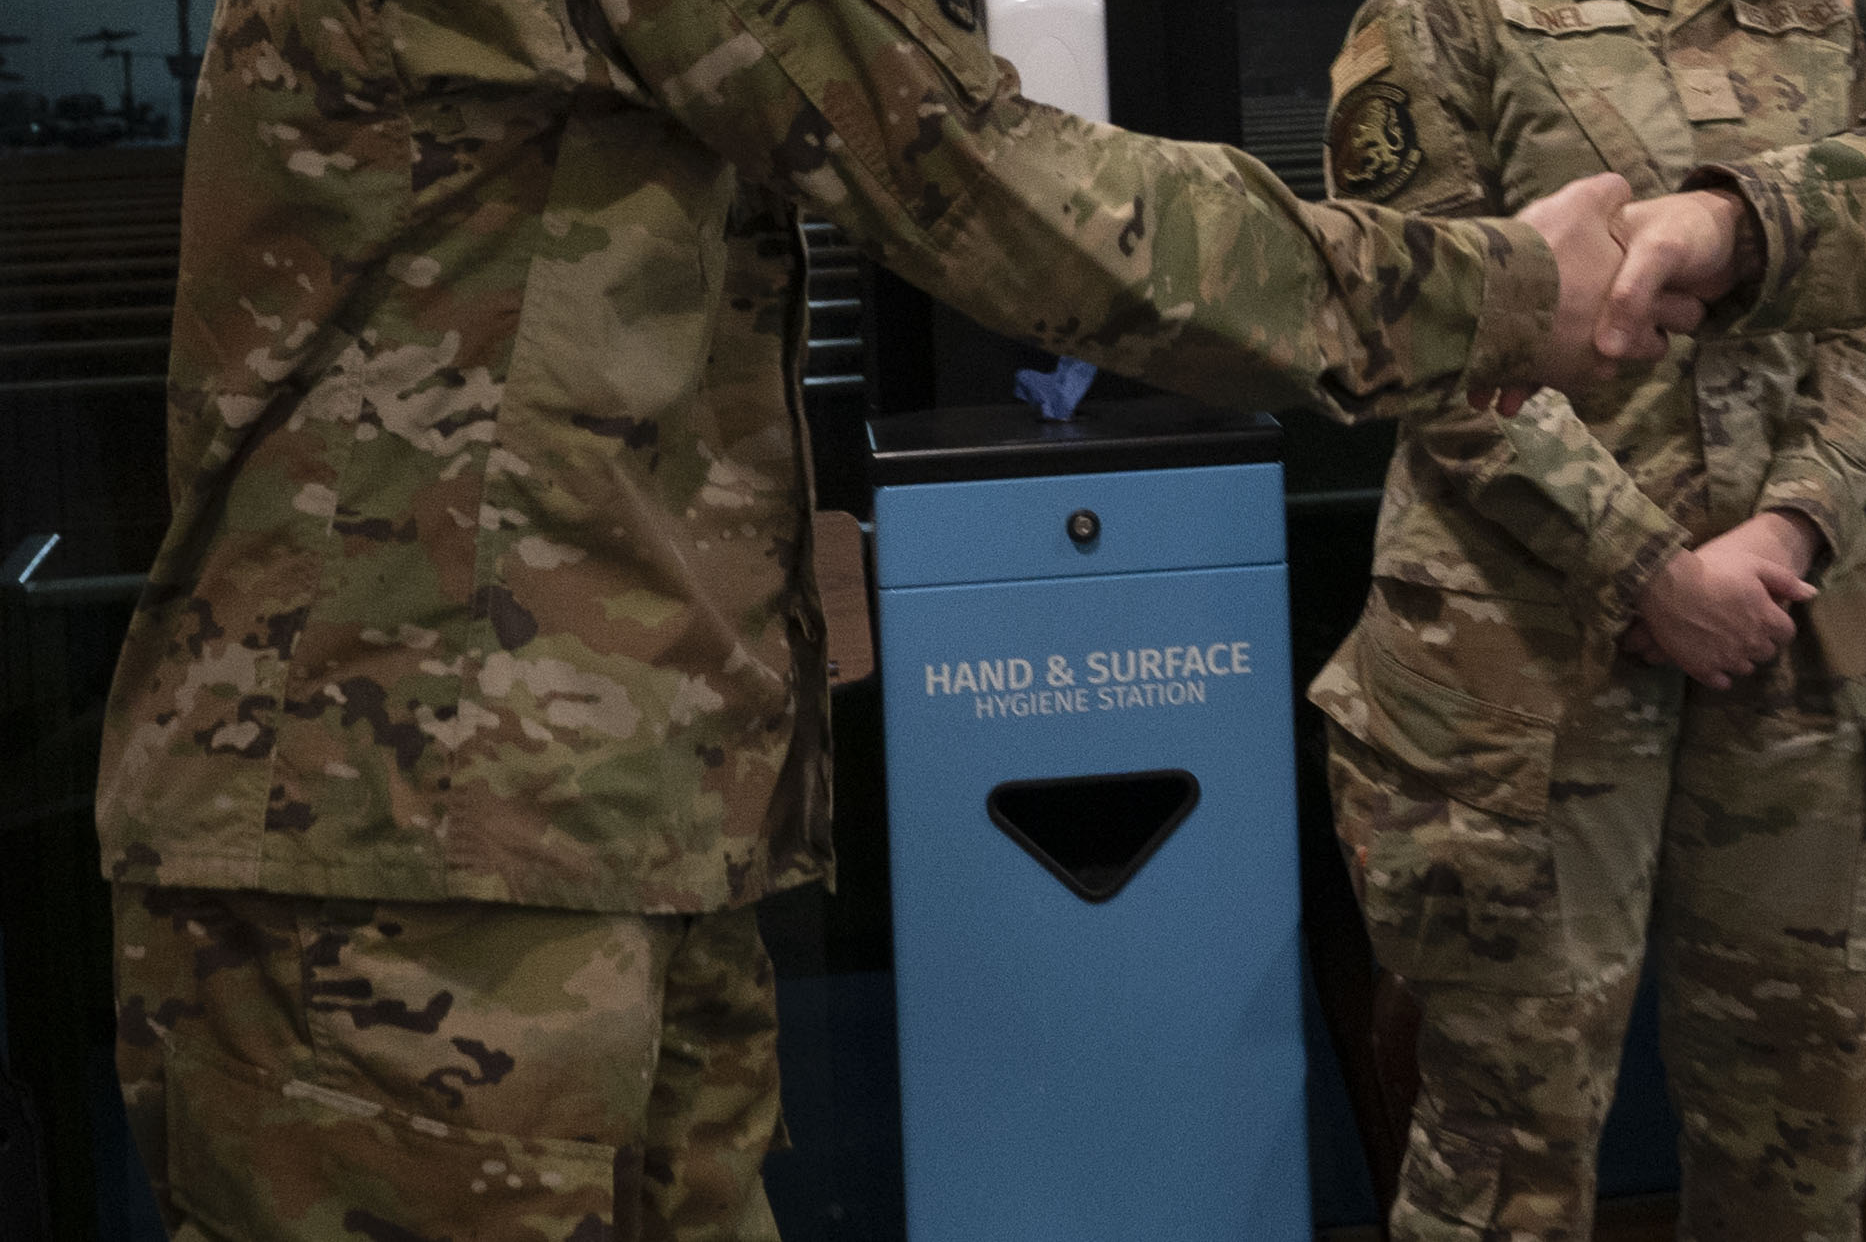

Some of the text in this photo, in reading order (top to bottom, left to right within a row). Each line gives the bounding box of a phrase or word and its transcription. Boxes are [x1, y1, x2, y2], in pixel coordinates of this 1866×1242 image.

[924, 641, 1252, 697] HAND & SURFACE
[974, 679, 1207, 719] HYGIENE STATION
